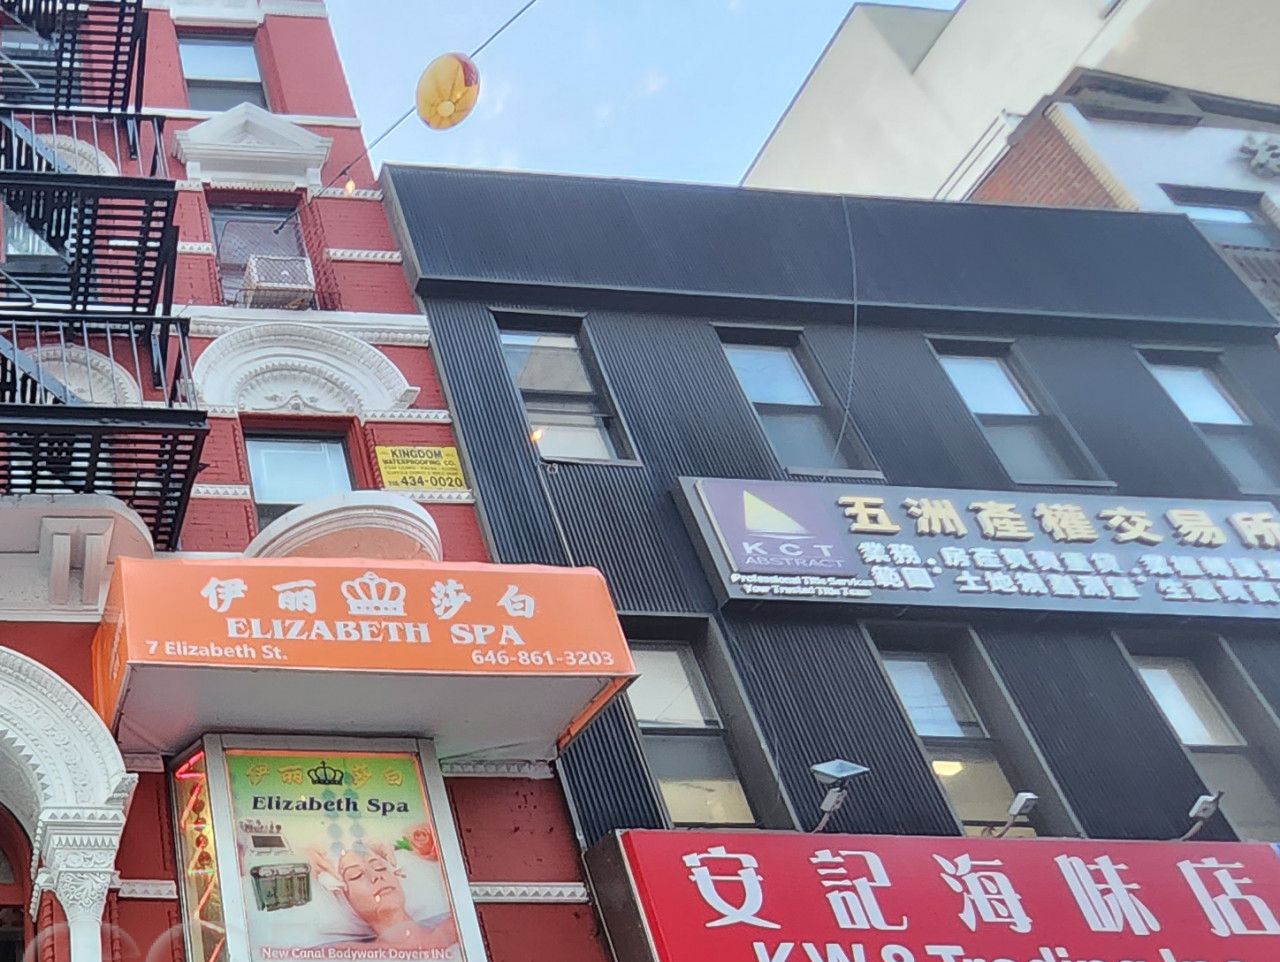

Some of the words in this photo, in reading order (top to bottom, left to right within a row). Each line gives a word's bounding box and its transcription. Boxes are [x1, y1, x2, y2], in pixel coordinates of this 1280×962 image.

[390, 448, 443, 459] KINGDOM
[400, 475, 463, 487] 434-0020
[744, 555, 848, 568] ABSTRACT
[227, 617, 431, 645] ELIZABETH
[450, 622, 526, 647] SPA
[146, 640, 158, 656] 7
[164, 640, 256, 660] Elizabeth
[261, 643, 288, 661] St.
[471, 648, 615, 668] 646-861-3203
[252, 795, 359, 812] Elizabeth
[366, 798, 409, 816] Spa
[682, 845, 1280, 938] 安記海味店
[261, 947, 289, 960] New
[291, 947, 325, 959] Canal
[328, 947, 386, 961] Bodywork
